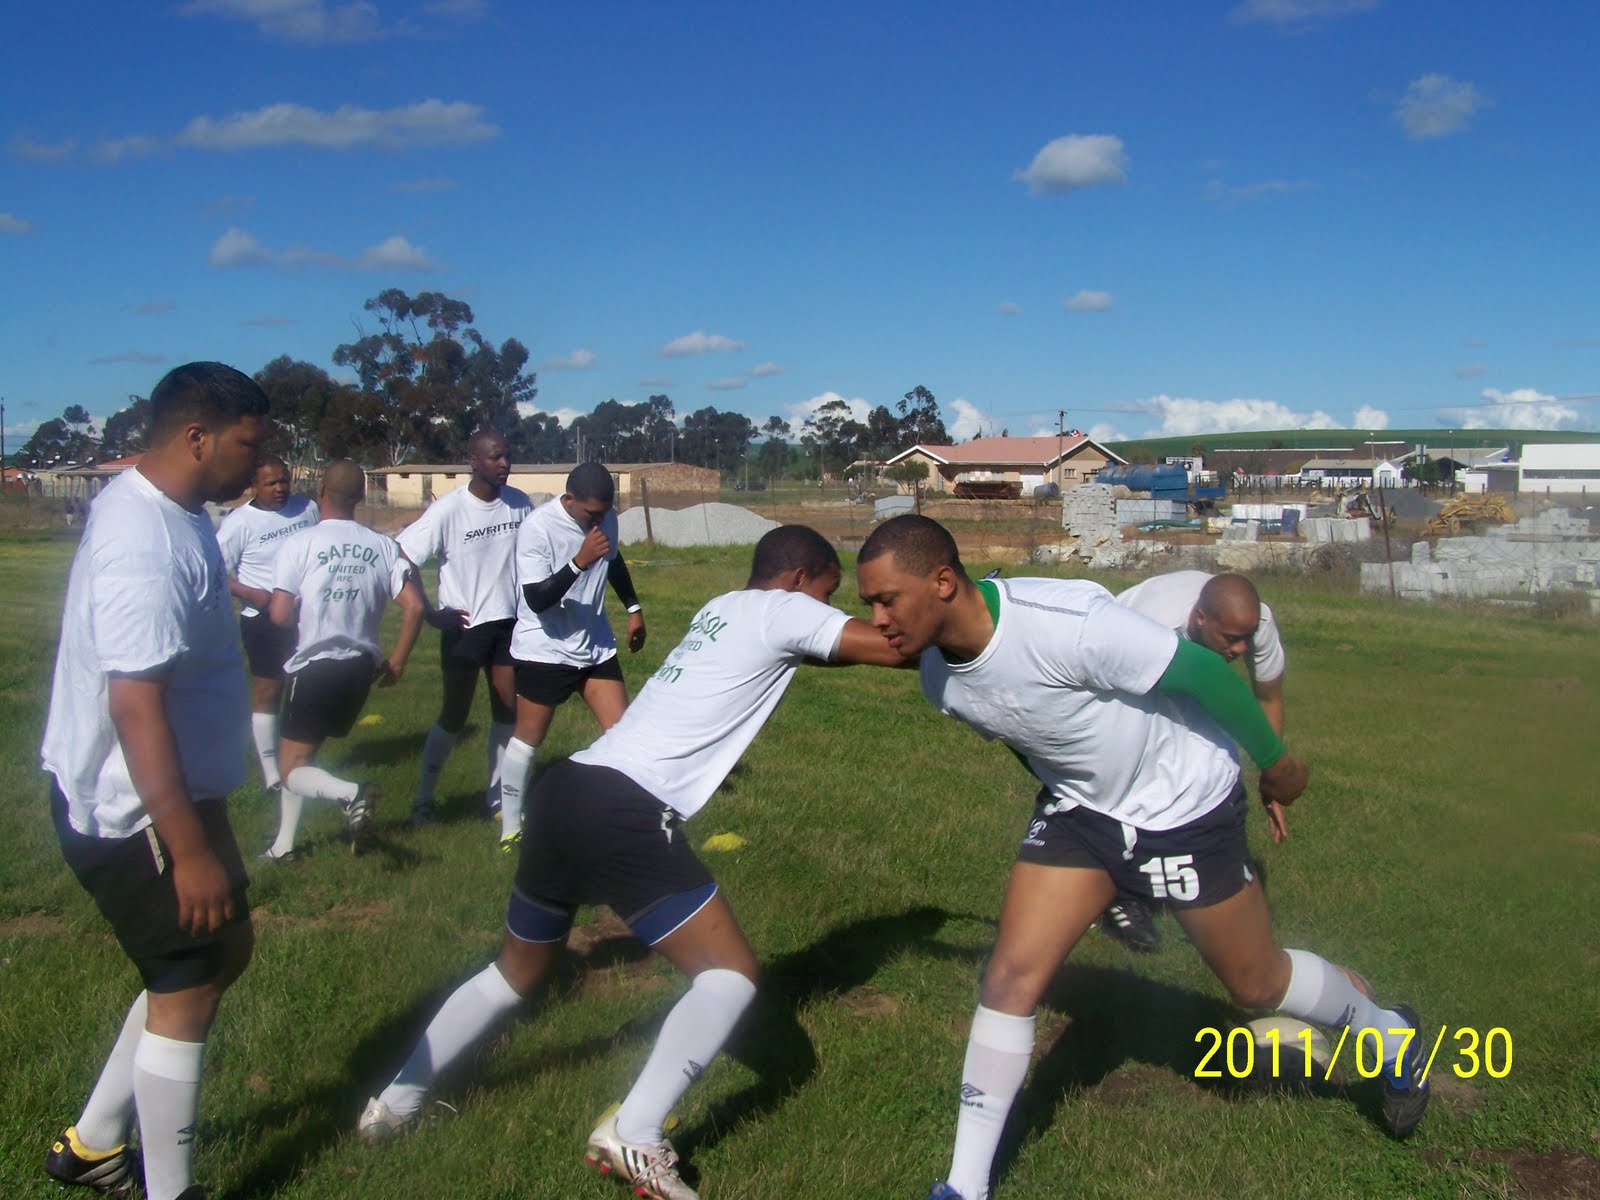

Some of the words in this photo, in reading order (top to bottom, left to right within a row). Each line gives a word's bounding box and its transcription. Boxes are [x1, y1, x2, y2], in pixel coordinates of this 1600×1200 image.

[317, 543, 379, 568] SAFCOL
[328, 564, 366, 574] UNITED
[322, 587, 361, 602] 2011
[1139, 854, 1200, 901] 15
